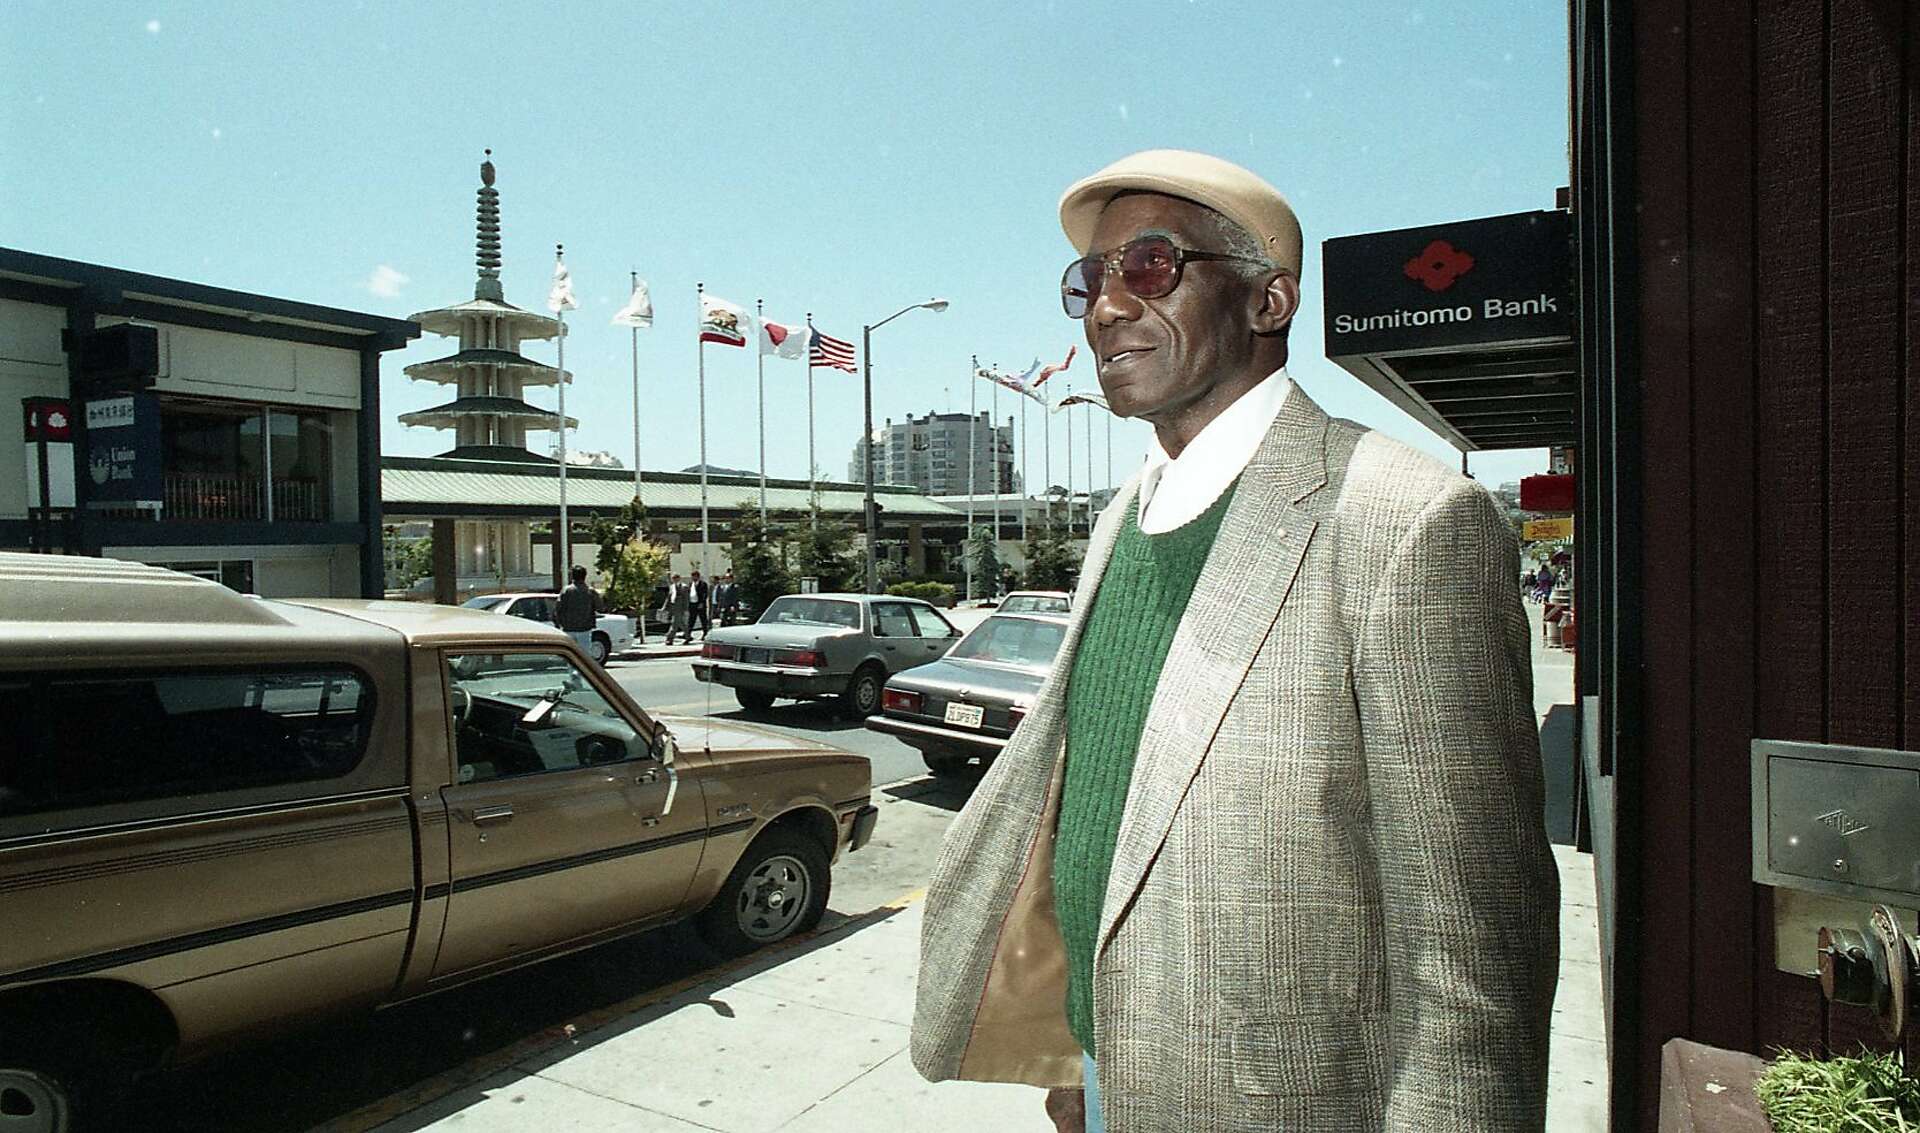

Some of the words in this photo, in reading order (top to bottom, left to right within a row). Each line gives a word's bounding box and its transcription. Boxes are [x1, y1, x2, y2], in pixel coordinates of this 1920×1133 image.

[1335, 306, 1473, 334] Sumitomo
[1484, 294, 1558, 319] Bank
[111, 447, 136, 462] Union
